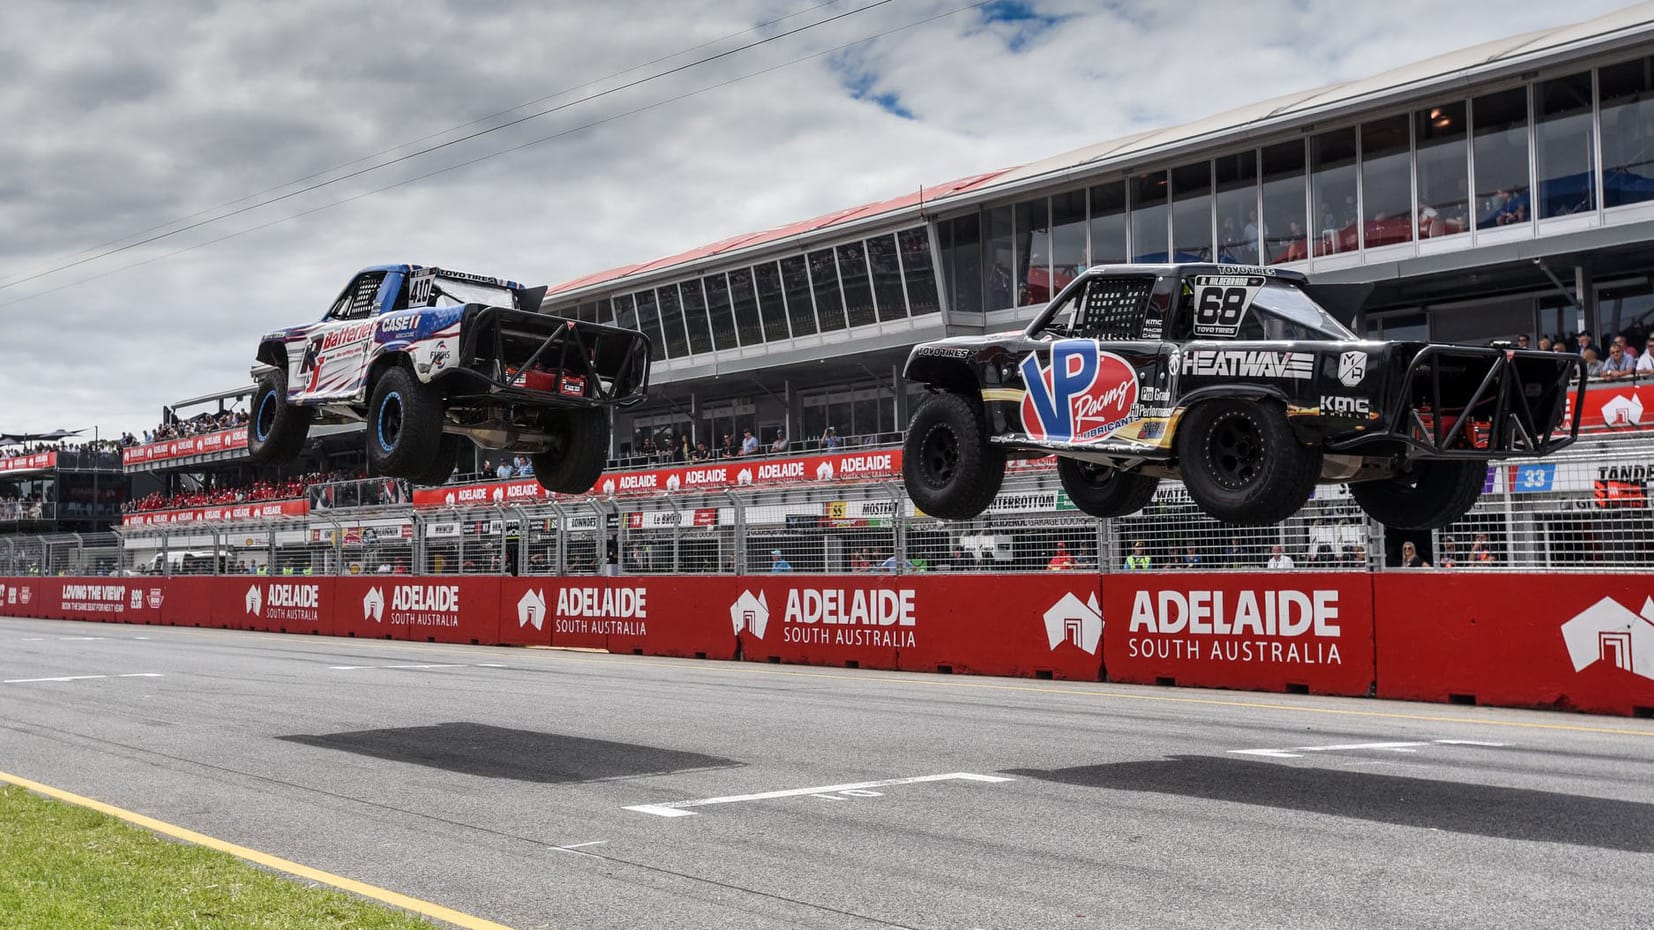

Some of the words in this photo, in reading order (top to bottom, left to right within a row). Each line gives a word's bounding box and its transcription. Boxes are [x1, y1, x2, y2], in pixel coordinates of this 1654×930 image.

[440, 269, 467, 279] TOYO
[467, 274, 496, 284] TIRES
[1218, 266, 1247, 274] TOYO
[1247, 267, 1276, 276] TIRES
[1209, 277, 1248, 286] HILDEBRAND
[411, 279, 431, 304] 410
[1197, 287, 1247, 325] 68
[382, 317, 409, 333] CASE
[430, 350, 450, 360] FUCHS
[919, 348, 941, 356] TOYO
[941, 349, 969, 358] TIRES
[1182, 350, 1314, 380] HEATWAVE
[1018, 339, 1100, 444] VP
[1141, 387, 1154, 401] Pro
[1154, 388, 1170, 401] Grade
[1075, 380, 1128, 433] Racing
[1320, 396, 1370, 413] KMC
[233, 431, 248, 441] ADELAID
[1076, 416, 1142, 440] LUBRICANTS
[758, 462, 804, 479] ADELAIDE
[840, 454, 892, 472] ADELAIDE
[685, 468, 726, 484] ADELAIDE
[1524, 469, 1546, 488] 33
[1598, 464, 1654, 481] TANDE
[620, 474, 657, 489] ADELAIDE
[458, 488, 486, 501] ADELAIDE
[507, 484, 538, 498] ADELAIDE
[263, 505, 282, 515] ADELAIDE
[862, 502, 898, 516] MOSTERT
[62, 585, 86, 600] LOVING
[88, 586, 102, 600] THE
[102, 586, 126, 600] VIEW?
[268, 584, 319, 608] ADELAIDE
[392, 586, 459, 612] ADELAIDE
[556, 587, 647, 618] ADELAIDE
[784, 588, 916, 626] ADELAIDE
[266, 609, 286, 619] SOUTH
[286, 610, 318, 620] AUSTRALIA
[391, 612, 415, 624] SOUTH
[417, 613, 458, 627] AUSTRALIA
[1128, 590, 1341, 637] ADELAIDE
[556, 620, 588, 632] SOUTH
[591, 621, 646, 636] AUSTRALIA
[784, 627, 830, 644] SOUTH
[836, 629, 916, 648] AUSTRALIA
[1128, 638, 1200, 660] SOUTH
[1210, 640, 1342, 665] AUSTRALIA
